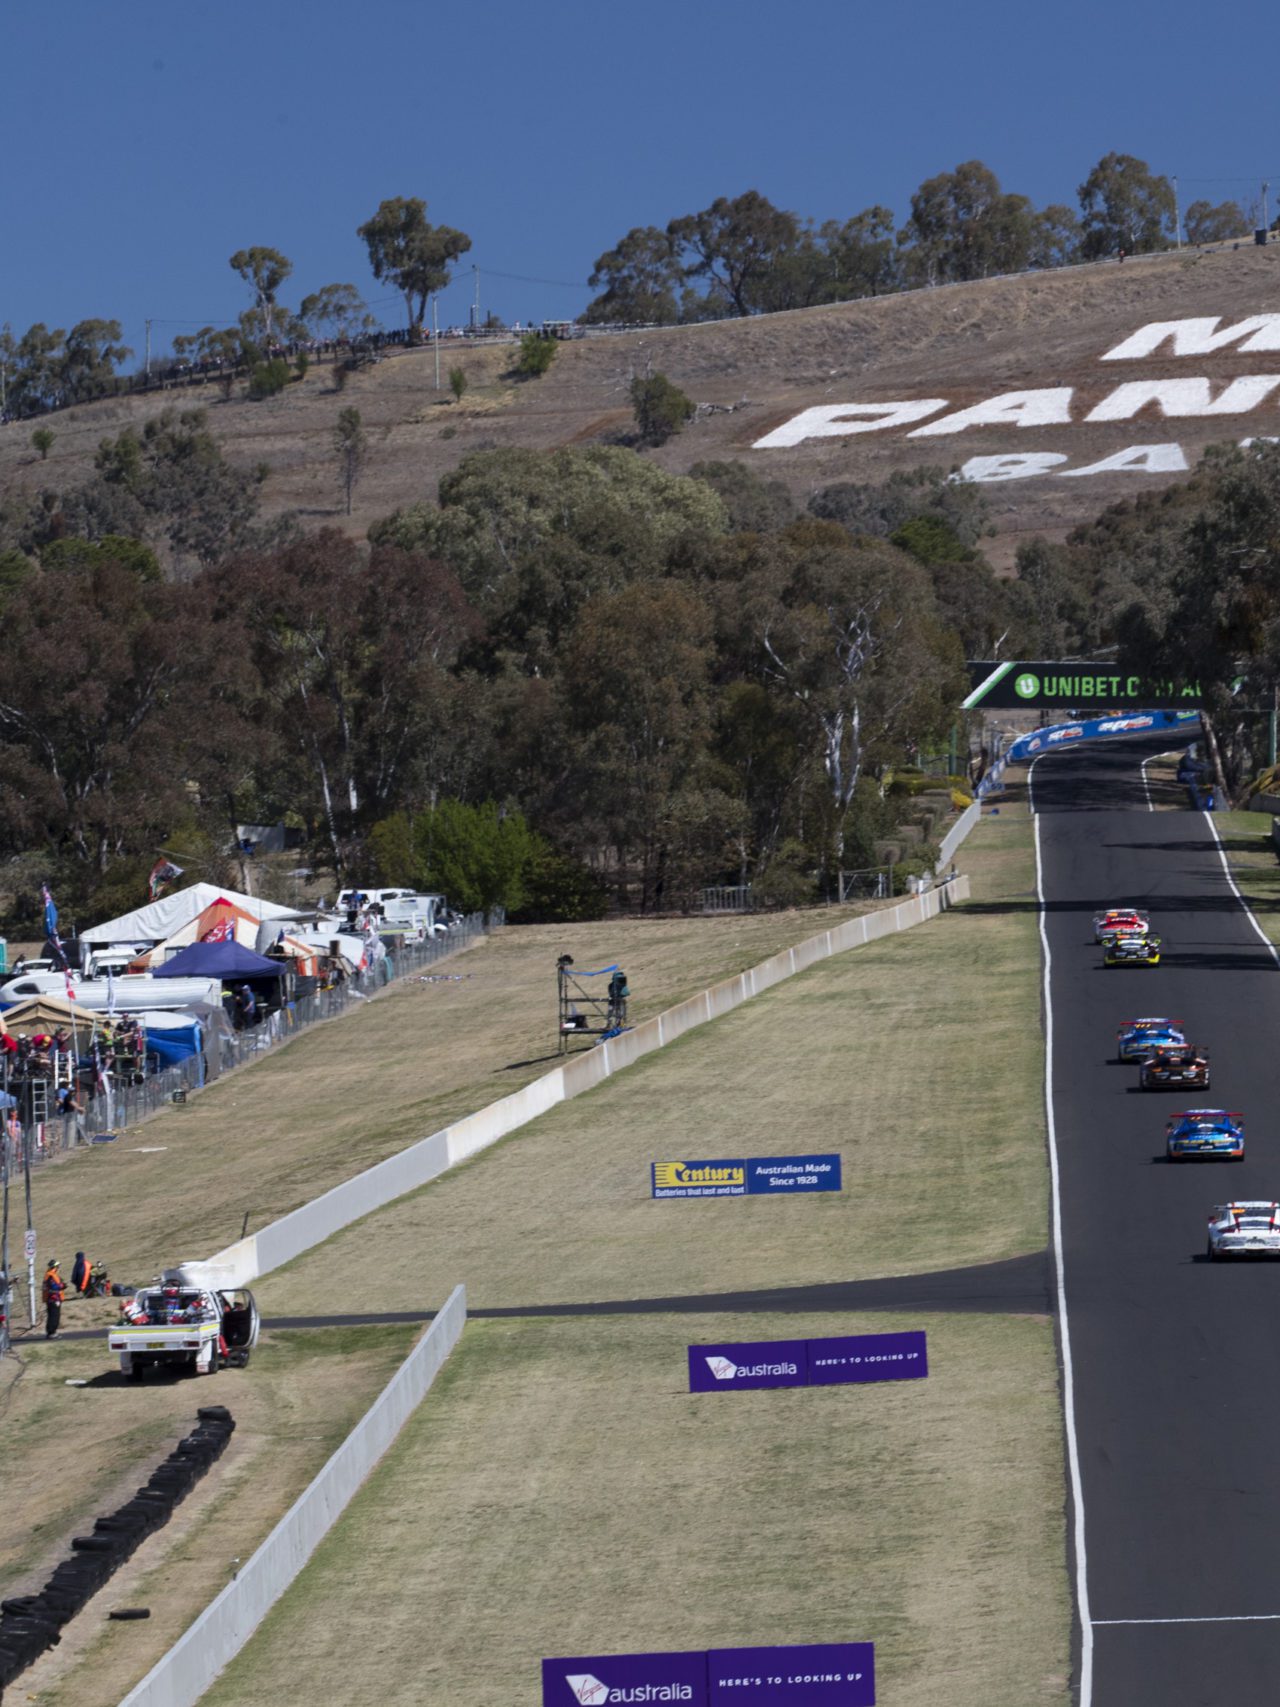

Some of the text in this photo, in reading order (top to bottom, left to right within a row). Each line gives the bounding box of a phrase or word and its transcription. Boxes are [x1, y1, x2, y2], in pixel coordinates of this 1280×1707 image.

[655, 1162, 744, 1188] Century
[755, 1164, 832, 1175] Australian Made
[769, 1175, 818, 1186] Since 1928
[655, 1188, 687, 1198] Batteries
[687, 1187, 702, 1196] that
[702, 1186, 716, 1195] last
[815, 1358, 846, 1366] HERE'S
[864, 1353, 904, 1363] LOOKING
[736, 1361, 798, 1378] australia
[718, 1672, 863, 1687] HERE'S TO LOOKING UP
[609, 1682, 693, 1703] australia
